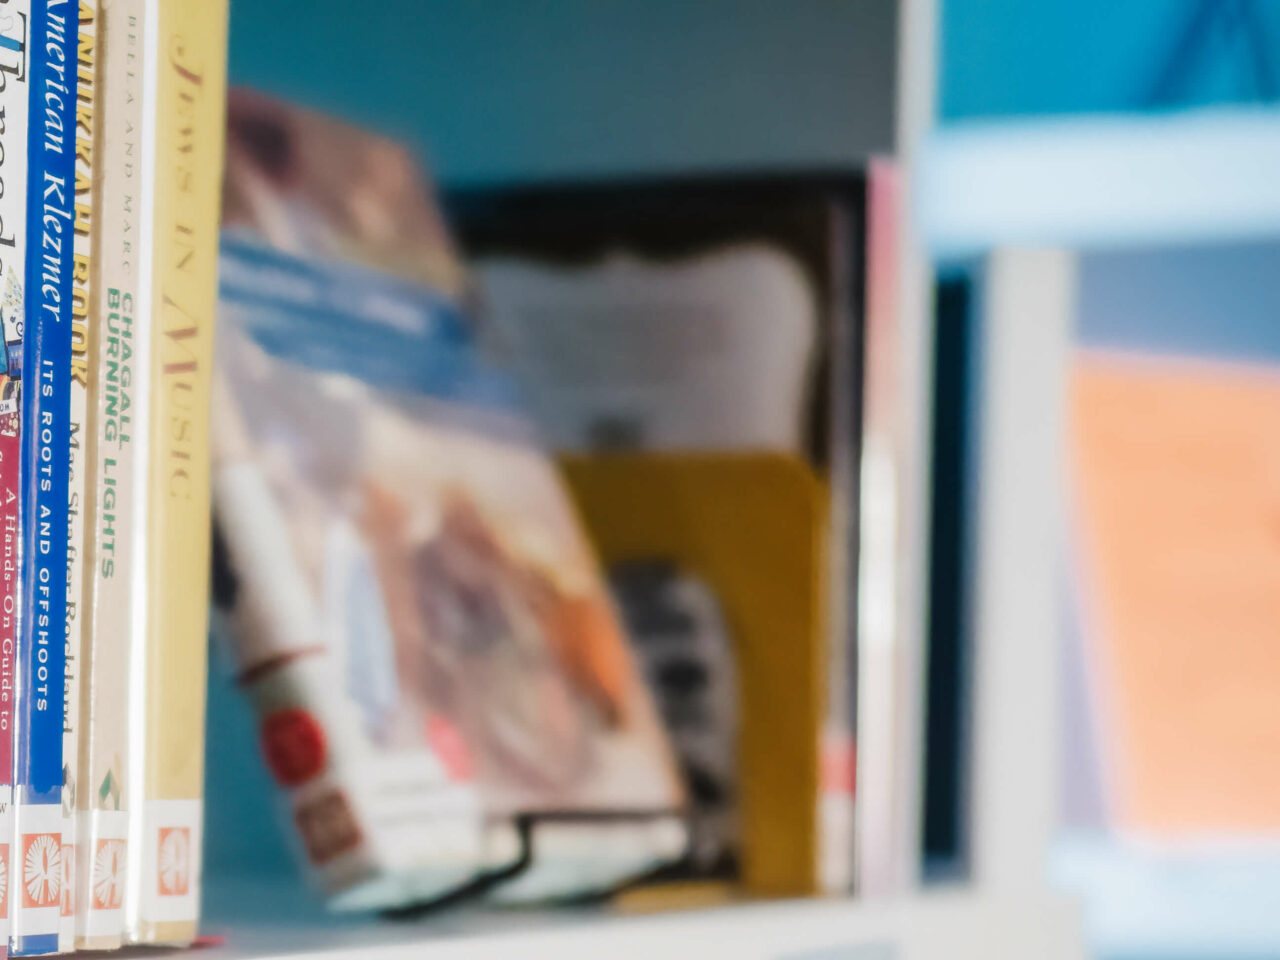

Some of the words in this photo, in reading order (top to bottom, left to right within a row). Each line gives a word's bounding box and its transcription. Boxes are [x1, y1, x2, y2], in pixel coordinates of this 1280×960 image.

[125, 15, 137, 105] BELLA
[124, 120, 135, 179] AND
[41, 170, 72, 323] Klezmer
[71, 253, 90, 390] BOOK
[104, 287, 120, 443] BURNING
[42, 360, 53, 397] ITS
[118, 291, 134, 450] CHAGALL
[6, 488, 17, 504] A
[41, 411, 53, 492] ROOTS
[40, 505, 52, 555] AND
[101, 457, 117, 579] LIGHTS
[3, 515, 16, 628] Hands-On
[1, 638, 13, 702] Guide
[37, 567, 50, 711] OFFSHOOTS
[0, 711, 8, 730] to
